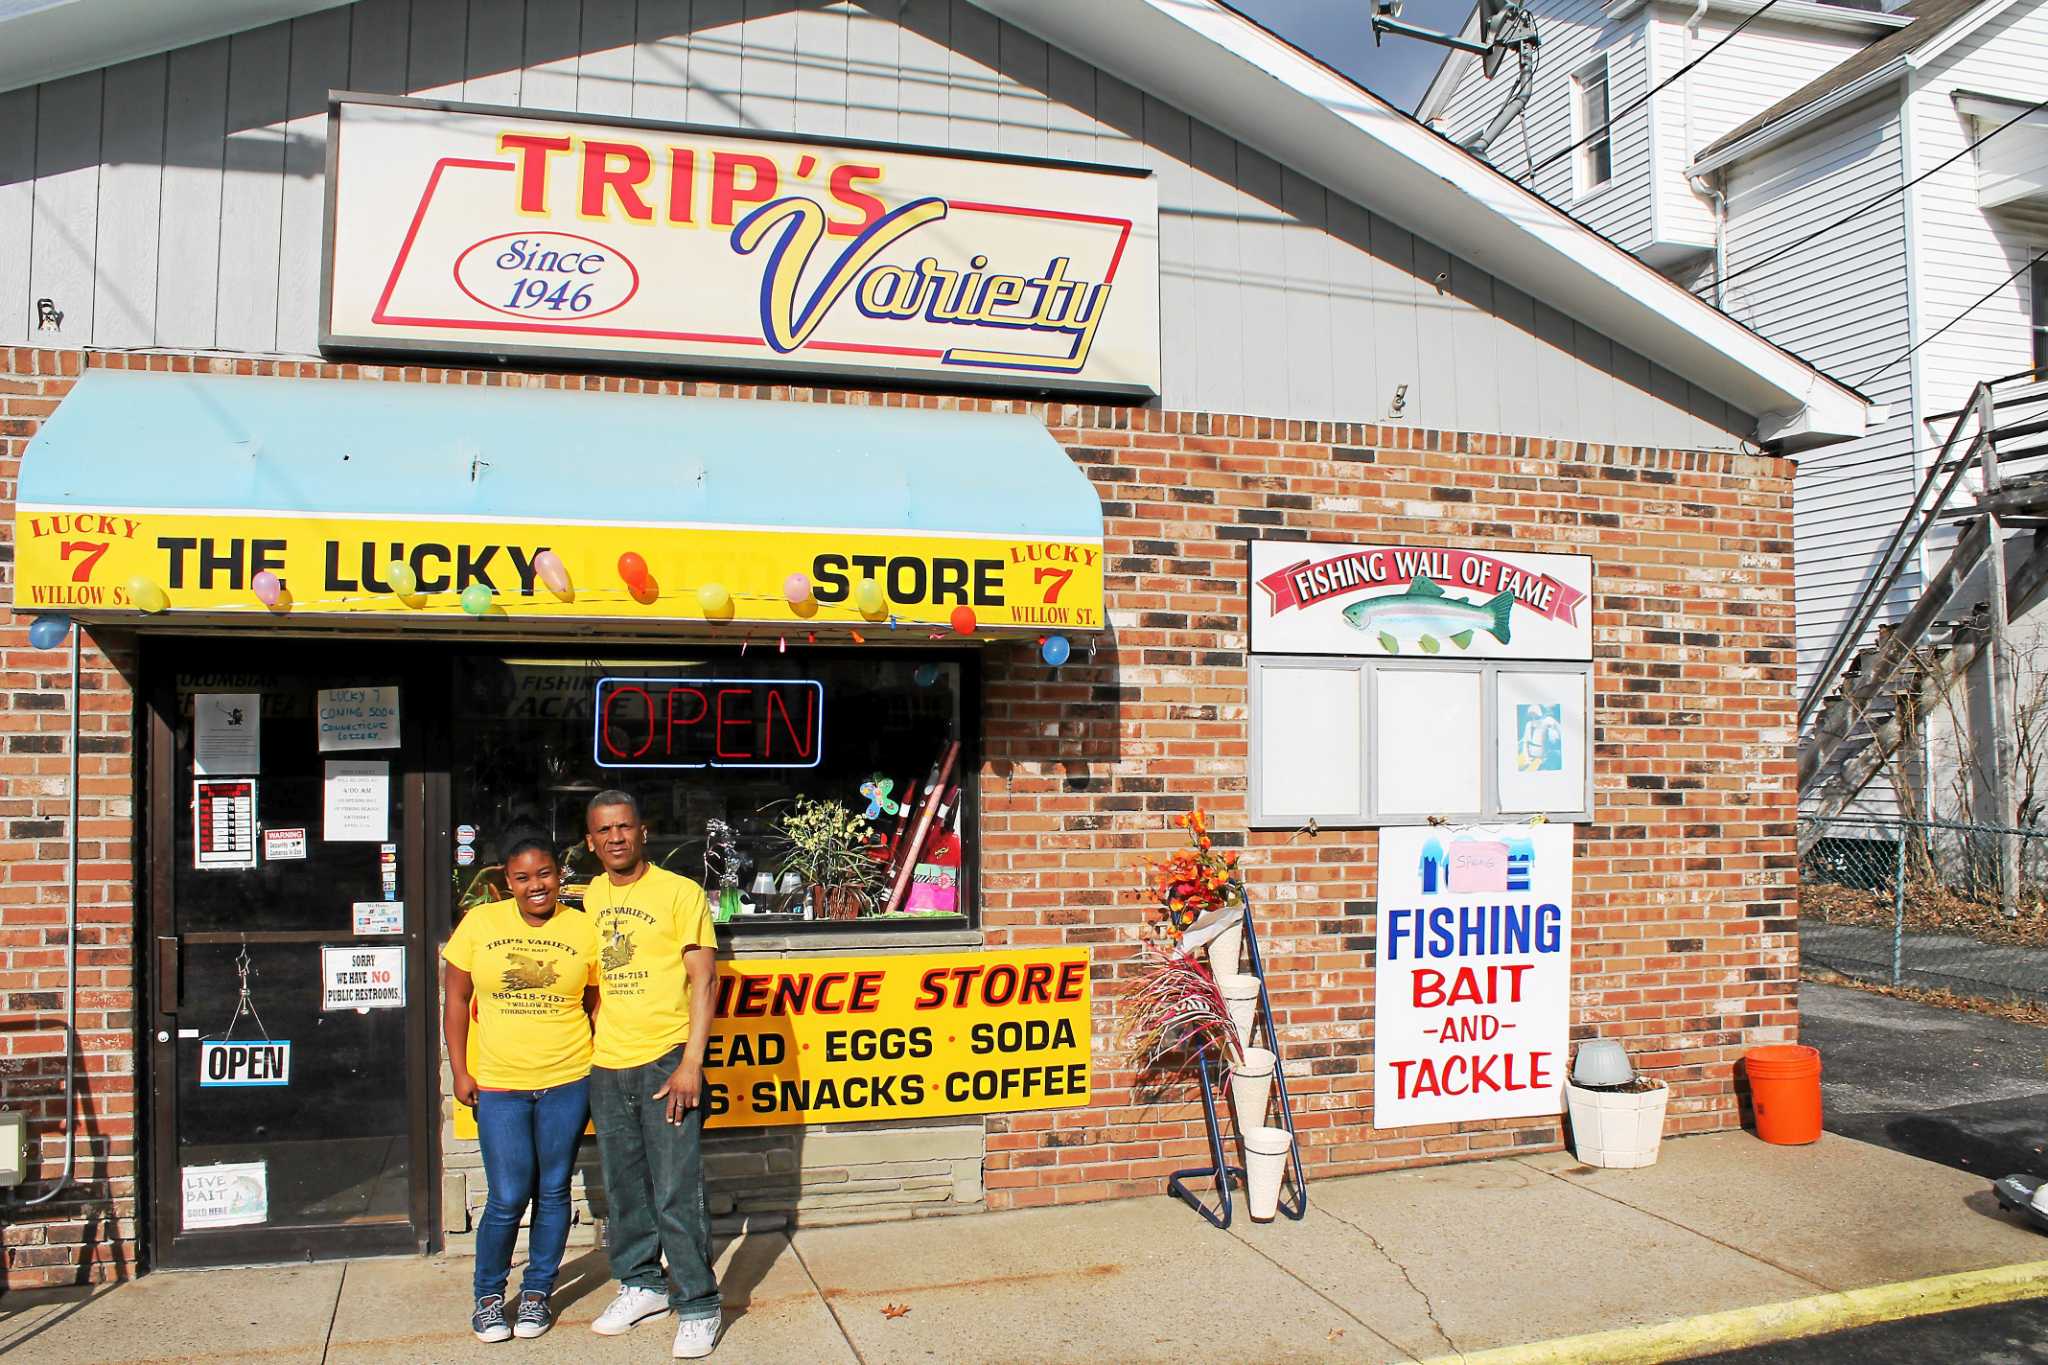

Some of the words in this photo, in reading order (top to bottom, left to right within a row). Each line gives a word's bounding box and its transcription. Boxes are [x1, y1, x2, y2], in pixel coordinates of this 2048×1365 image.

[499, 130, 889, 239] TRIP'S
[495, 239, 606, 276] Since
[502, 279, 594, 314] 1946
[730, 197, 1112, 374] Variety
[30, 514, 141, 539] LUCKY
[61, 541, 110, 582] 7
[157, 537, 287, 591] THE
[325, 541, 551, 596] LUCKY
[812, 553, 1005, 607] STORE
[1010, 544, 1098, 566] LUCKY
[32, 585, 104, 604] WILLOW
[1034, 567, 1073, 603] 7
[1294, 553, 1387, 602] FISHING
[1394, 550, 1453, 581] WALL
[1461, 556, 1494, 587] OF
[1497, 565, 1557, 612] FAME
[1011, 606, 1069, 623] WILLOW
[1076, 607, 1096, 624] ST.
[603, 687, 813, 758] OPEN
[268, 831, 302, 839] WARNING
[614, 907, 656, 925] VARIETY
[1388, 904, 1561, 960] FISHING
[352, 955, 375, 967] SORRY
[527, 939, 578, 956] VARIETY
[336, 972, 347, 984] WE
[349, 972, 367, 984] HAVE
[372, 970, 390, 983] NO
[715, 970, 886, 1019] IENCE
[915, 960, 1088, 1011] STORE
[1411, 964, 1535, 1008] BAIT
[328, 989, 353, 1002] PUBLIC
[355, 987, 400, 1001] RESTROOMS.
[491, 992, 566, 1003] 860-618-7151
[703, 1033, 785, 1067] EAD
[825, 1026, 933, 1062] EGGS
[971, 1018, 1077, 1055] SODA
[209, 1046, 284, 1080] OPEN
[1388, 1052, 1553, 1099] TACKLE
[751, 1074, 925, 1114] SNACKS
[945, 1063, 1087, 1102] COFFEE
[186, 1189, 228, 1202] BAIT
[187, 1175, 225, 1189] LIVE
[187, 1208, 207, 1217] SOLD
[209, 1206, 228, 1216] HERE
